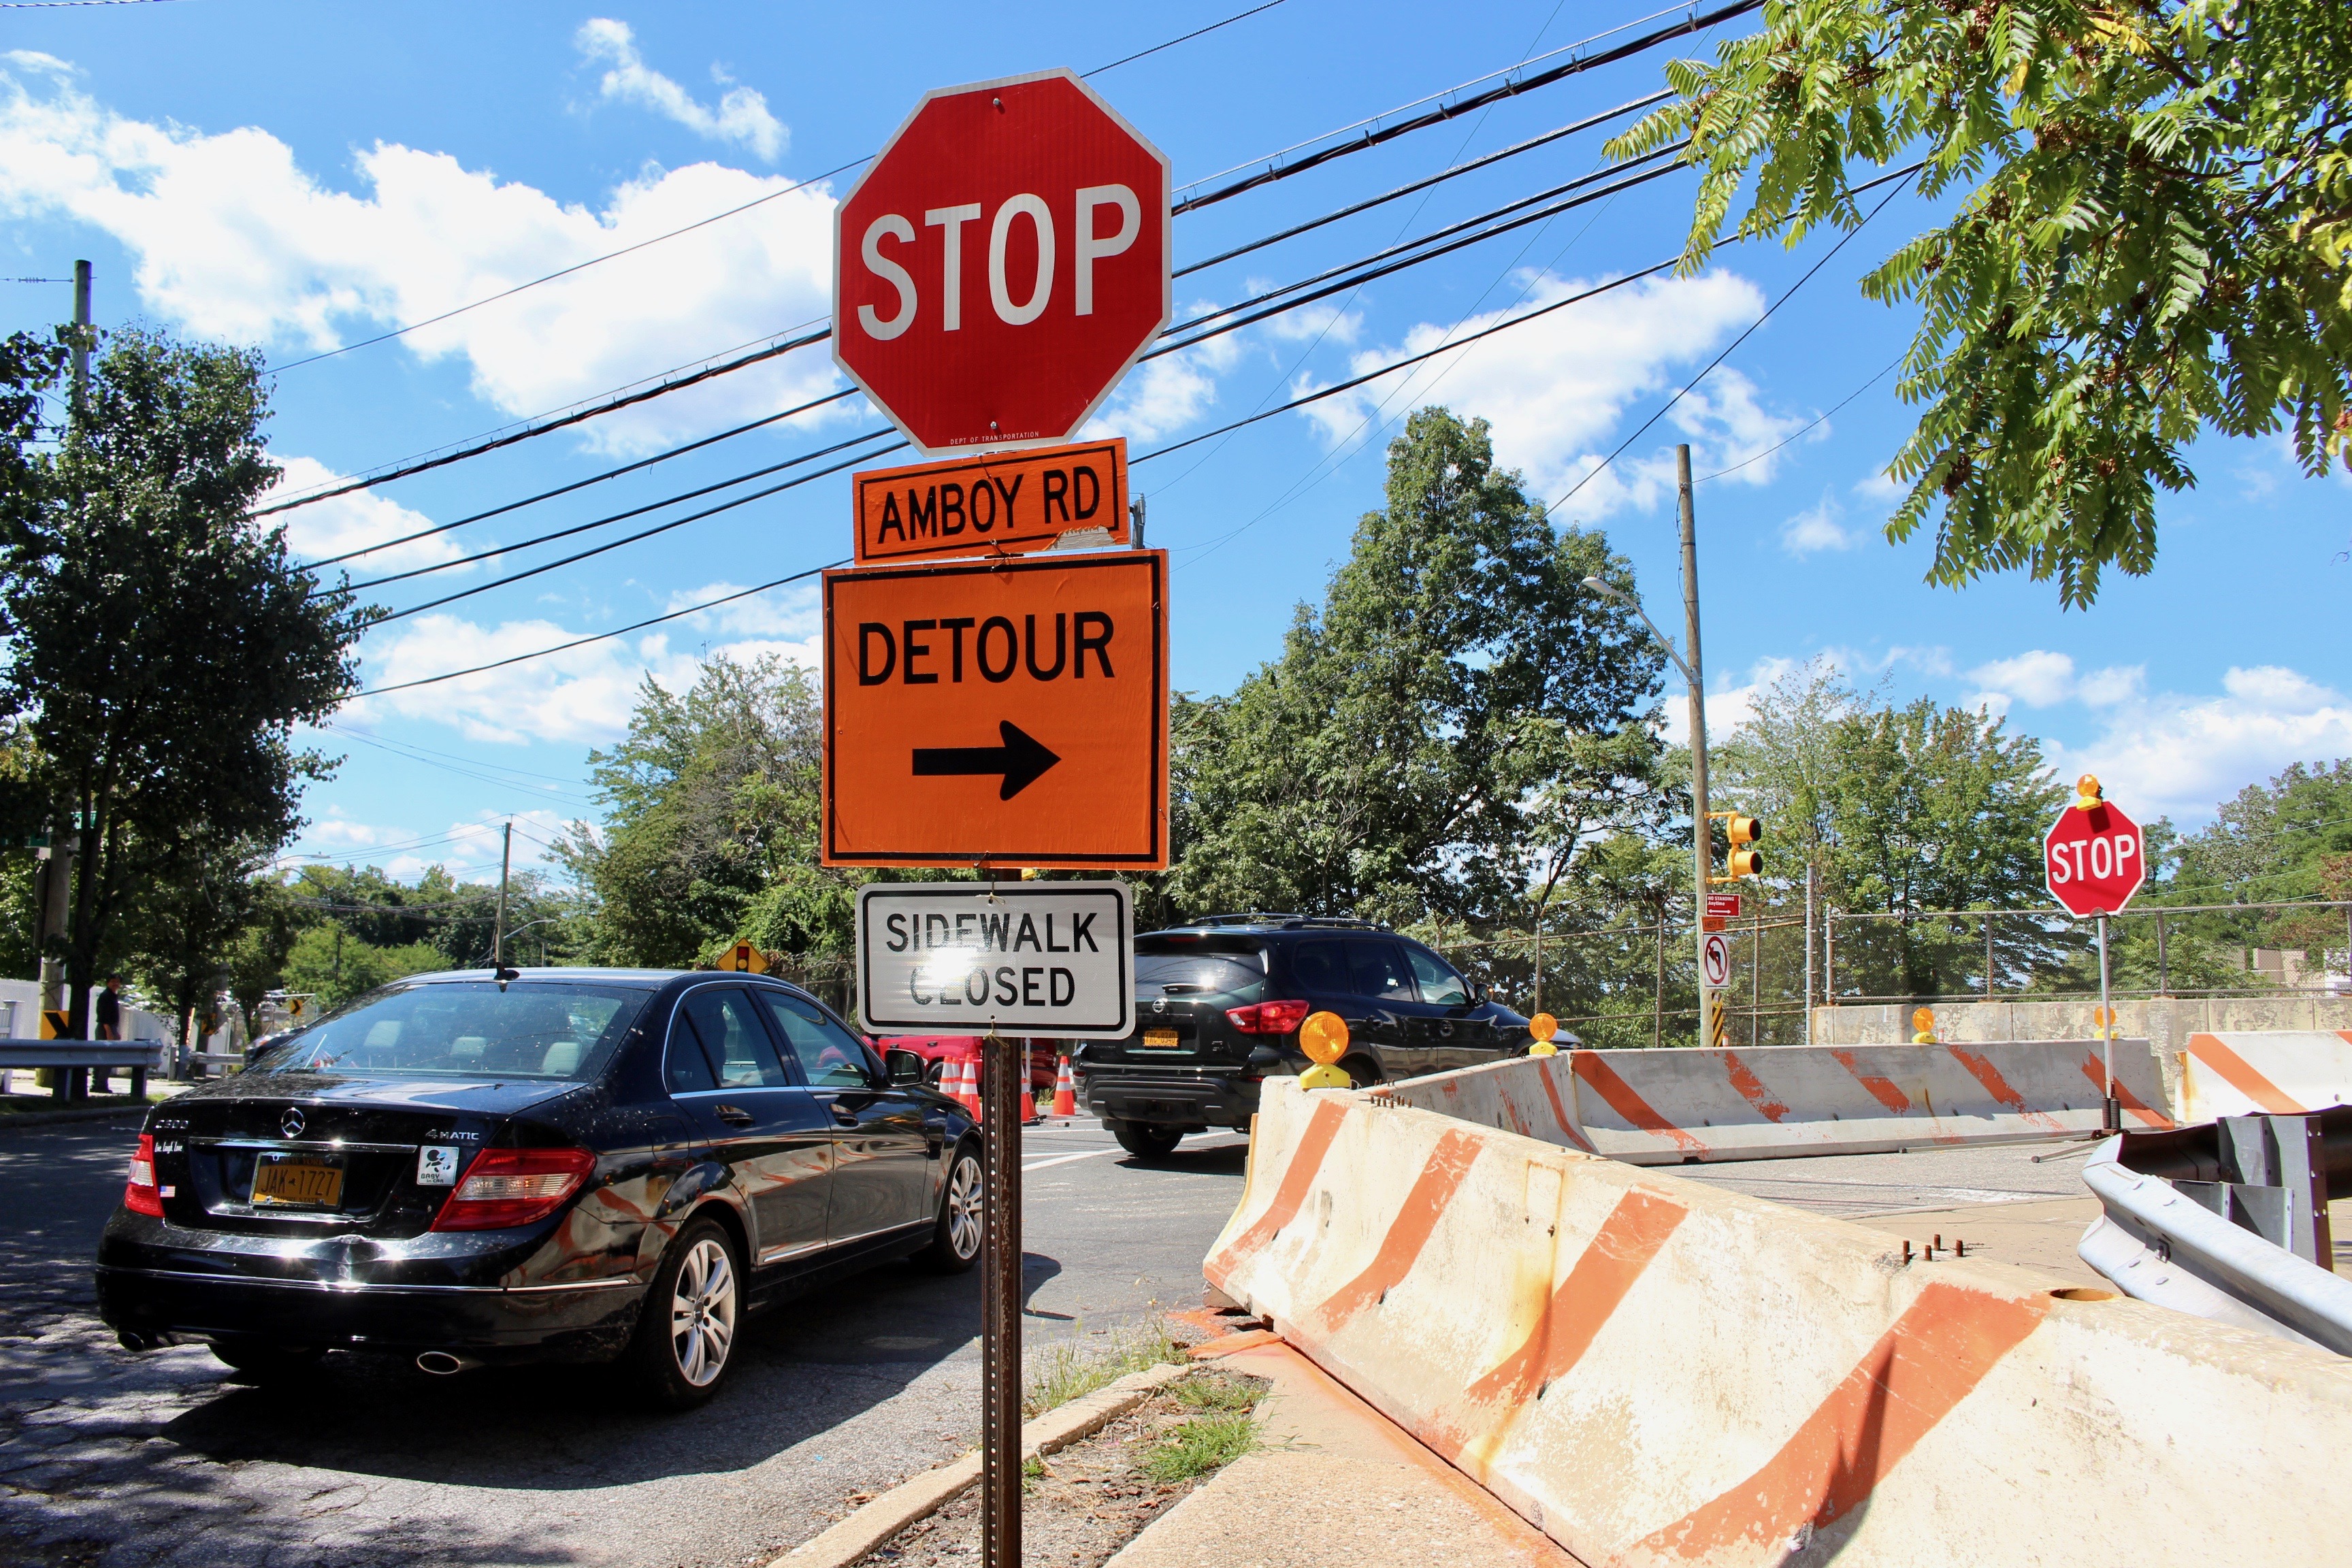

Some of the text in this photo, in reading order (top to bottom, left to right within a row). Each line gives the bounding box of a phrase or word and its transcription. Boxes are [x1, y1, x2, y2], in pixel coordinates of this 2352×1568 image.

[857, 183, 1141, 341] STOP
[982, 431, 1039, 442] TRANSPORTATION
[877, 466, 1100, 544] AMBOY RD
[858, 610, 1115, 687] DETOUR
[2051, 834, 2136, 884] STOP
[886, 913, 1099, 953] SIDEWALK
[425, 1128, 479, 1140] 4MATIC
[302, 1158, 325, 1166] YORK
